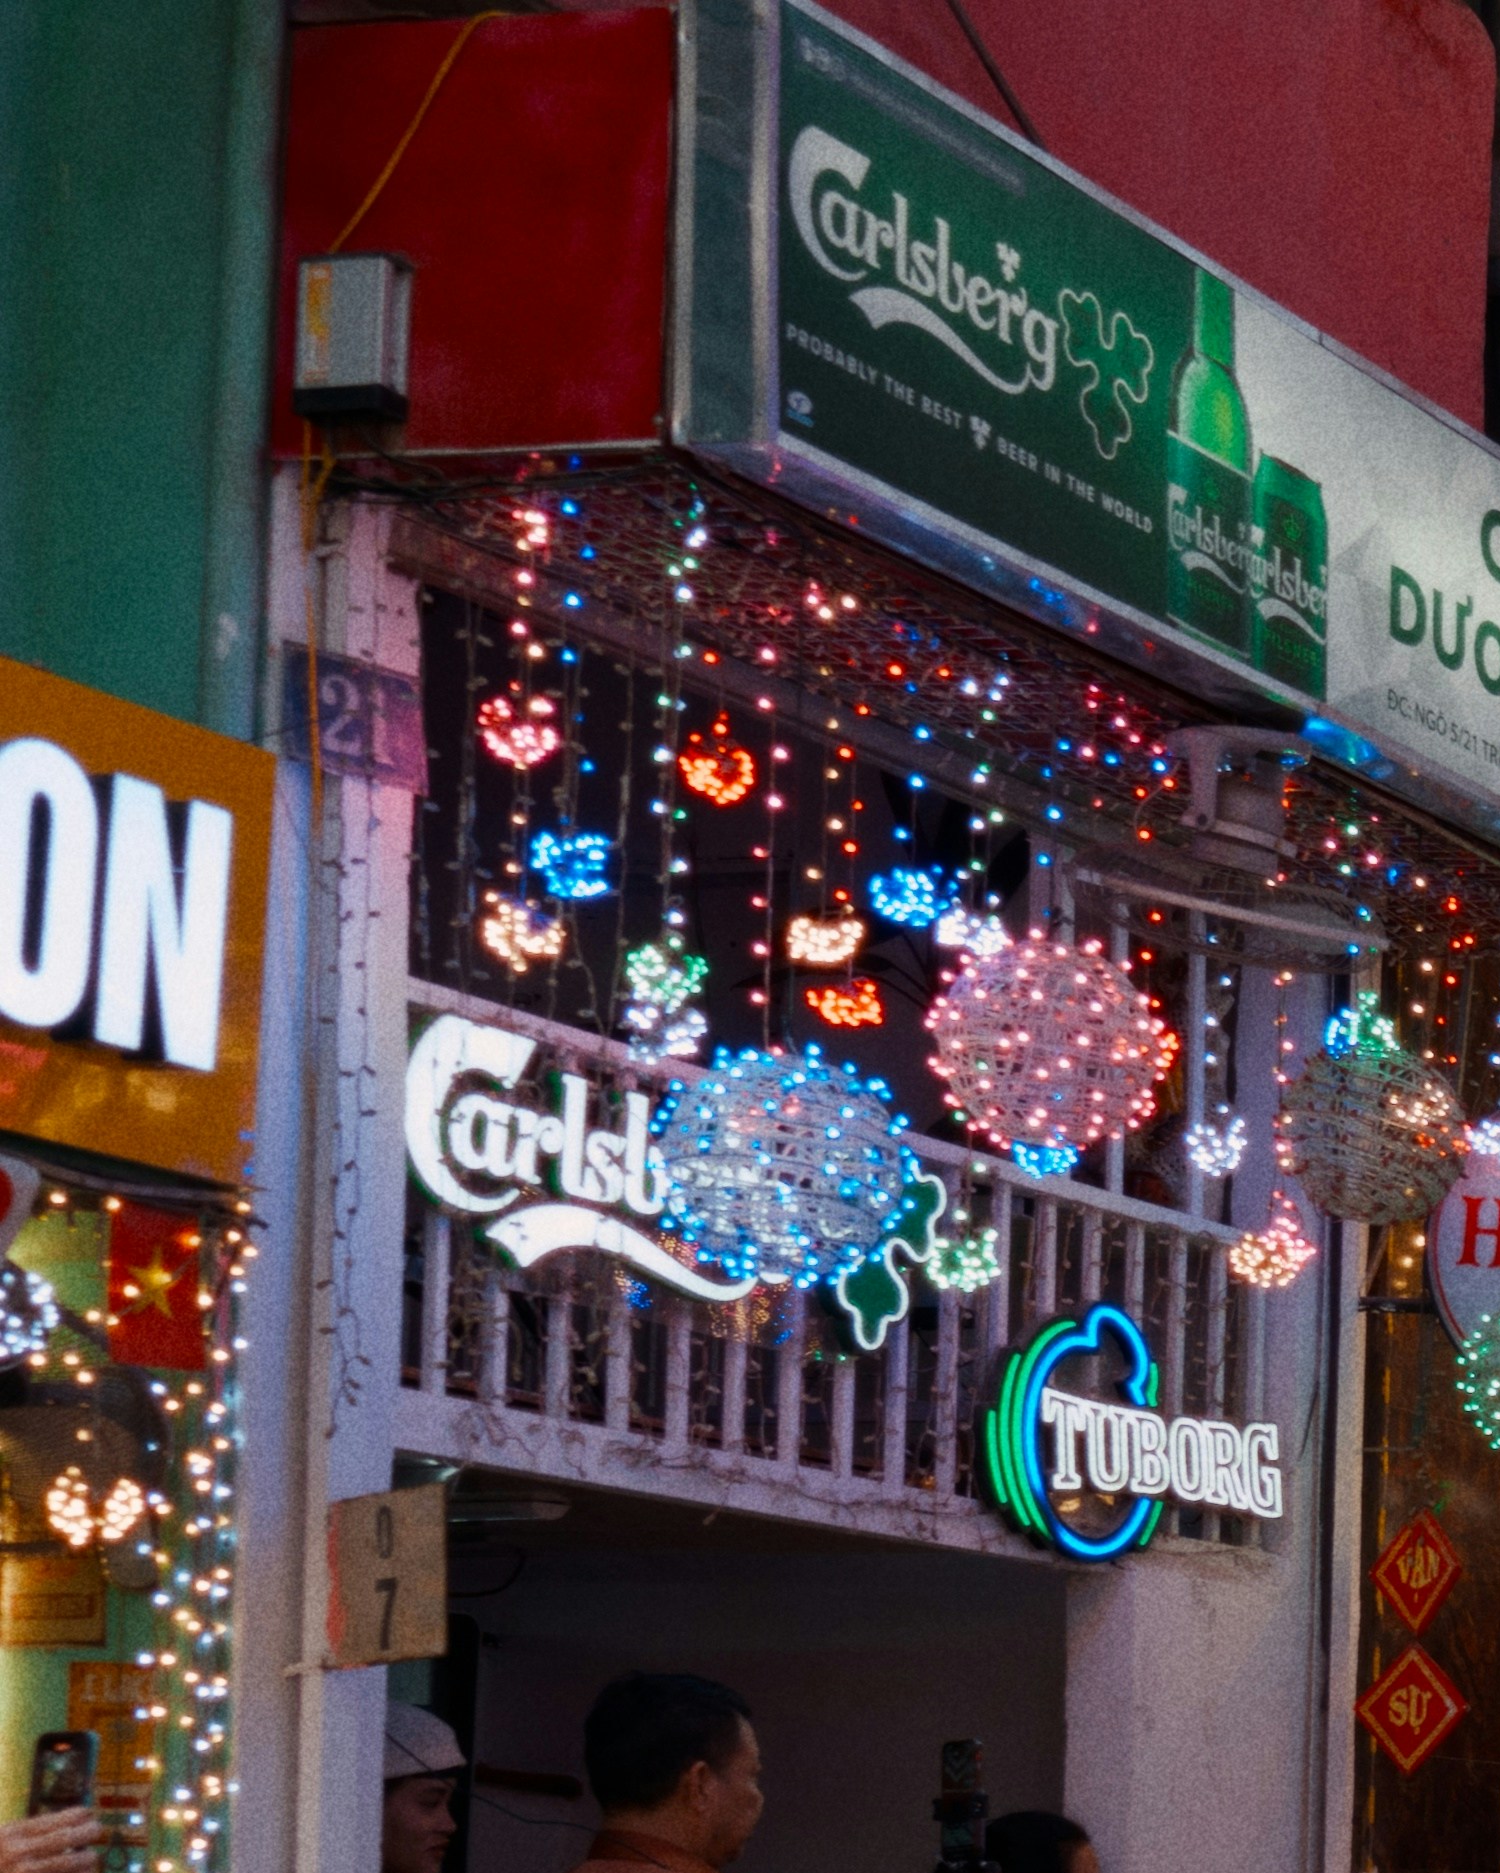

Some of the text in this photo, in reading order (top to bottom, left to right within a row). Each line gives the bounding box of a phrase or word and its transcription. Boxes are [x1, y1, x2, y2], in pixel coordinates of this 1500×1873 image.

[789, 126, 1059, 393] Carlsberg
[785, 322, 1154, 534] PROBABLY THE BEST BEER IN THE WORLD
[1168, 482, 1249, 577] Carlsber
[0, 736, 234, 1072] ON
[404, 1015, 770, 1288] Carlsb
[1041, 1385, 1284, 1519] TUBORG
